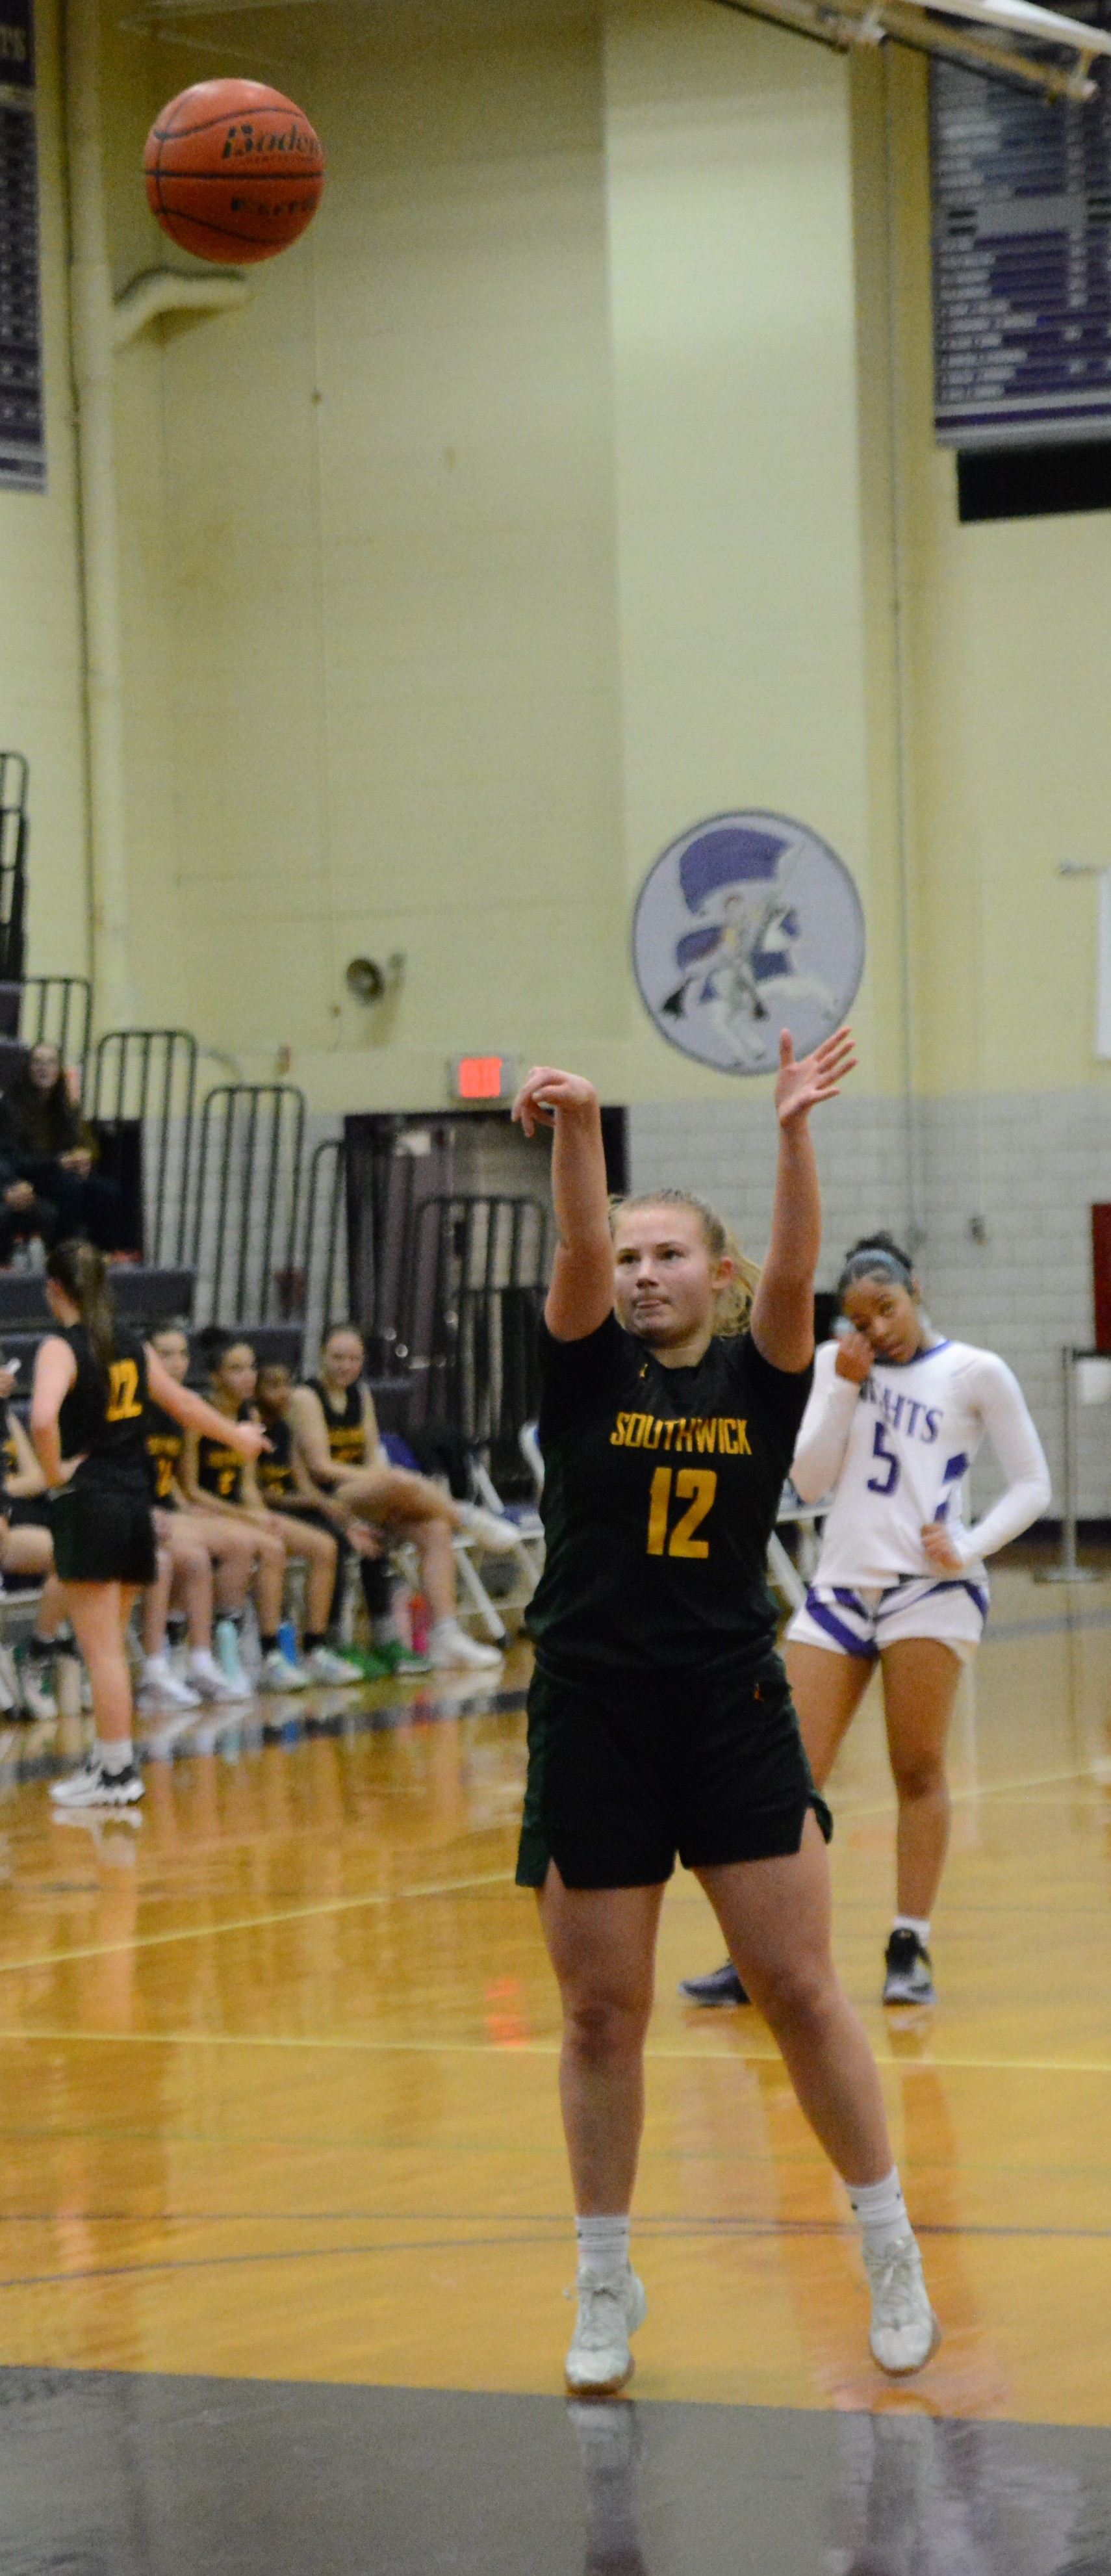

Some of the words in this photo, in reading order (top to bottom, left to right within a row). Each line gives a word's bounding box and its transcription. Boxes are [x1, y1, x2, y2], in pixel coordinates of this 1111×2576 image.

[610, 1411, 752, 1455] SOUTHWICK
[867, 1421, 900, 1497] 5
[646, 1466, 717, 1559] 12
